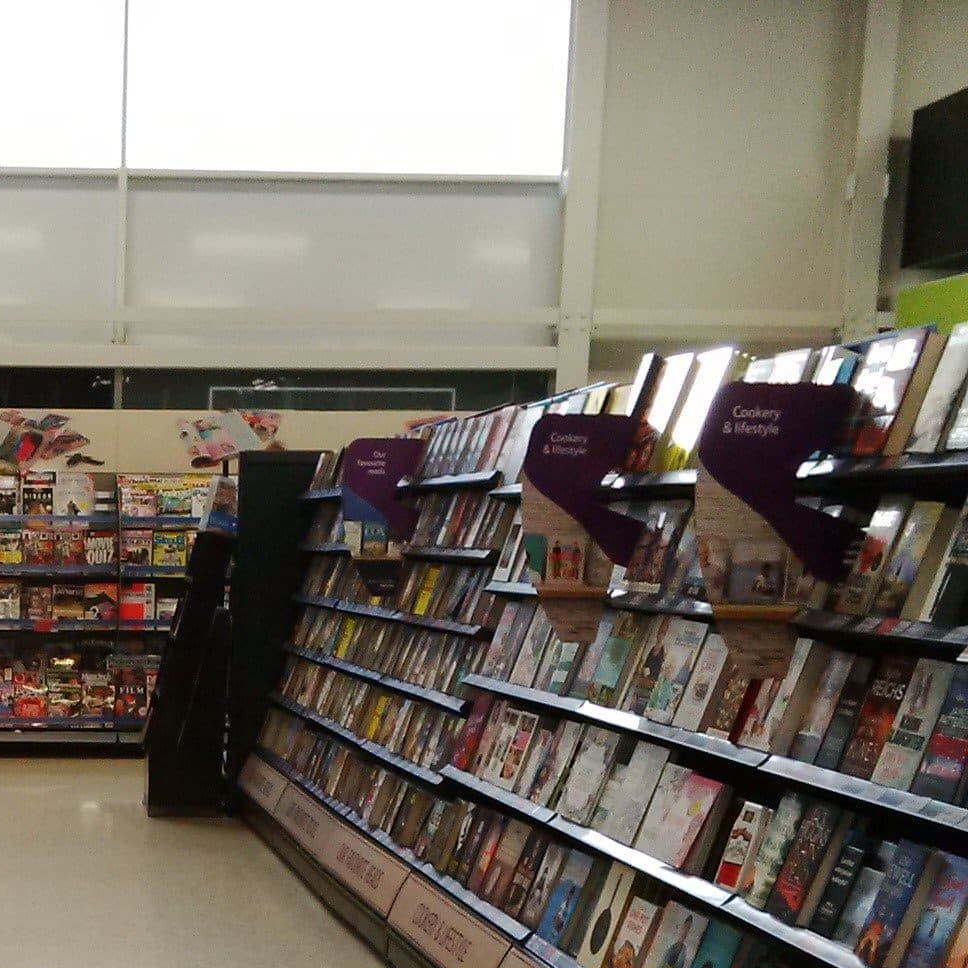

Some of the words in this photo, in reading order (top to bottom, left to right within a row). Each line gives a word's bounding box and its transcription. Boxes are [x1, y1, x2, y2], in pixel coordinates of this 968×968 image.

[732, 404, 781, 421] Cookery
[722, 421, 733, 434] &
[734, 421, 779, 437] lifestyle
